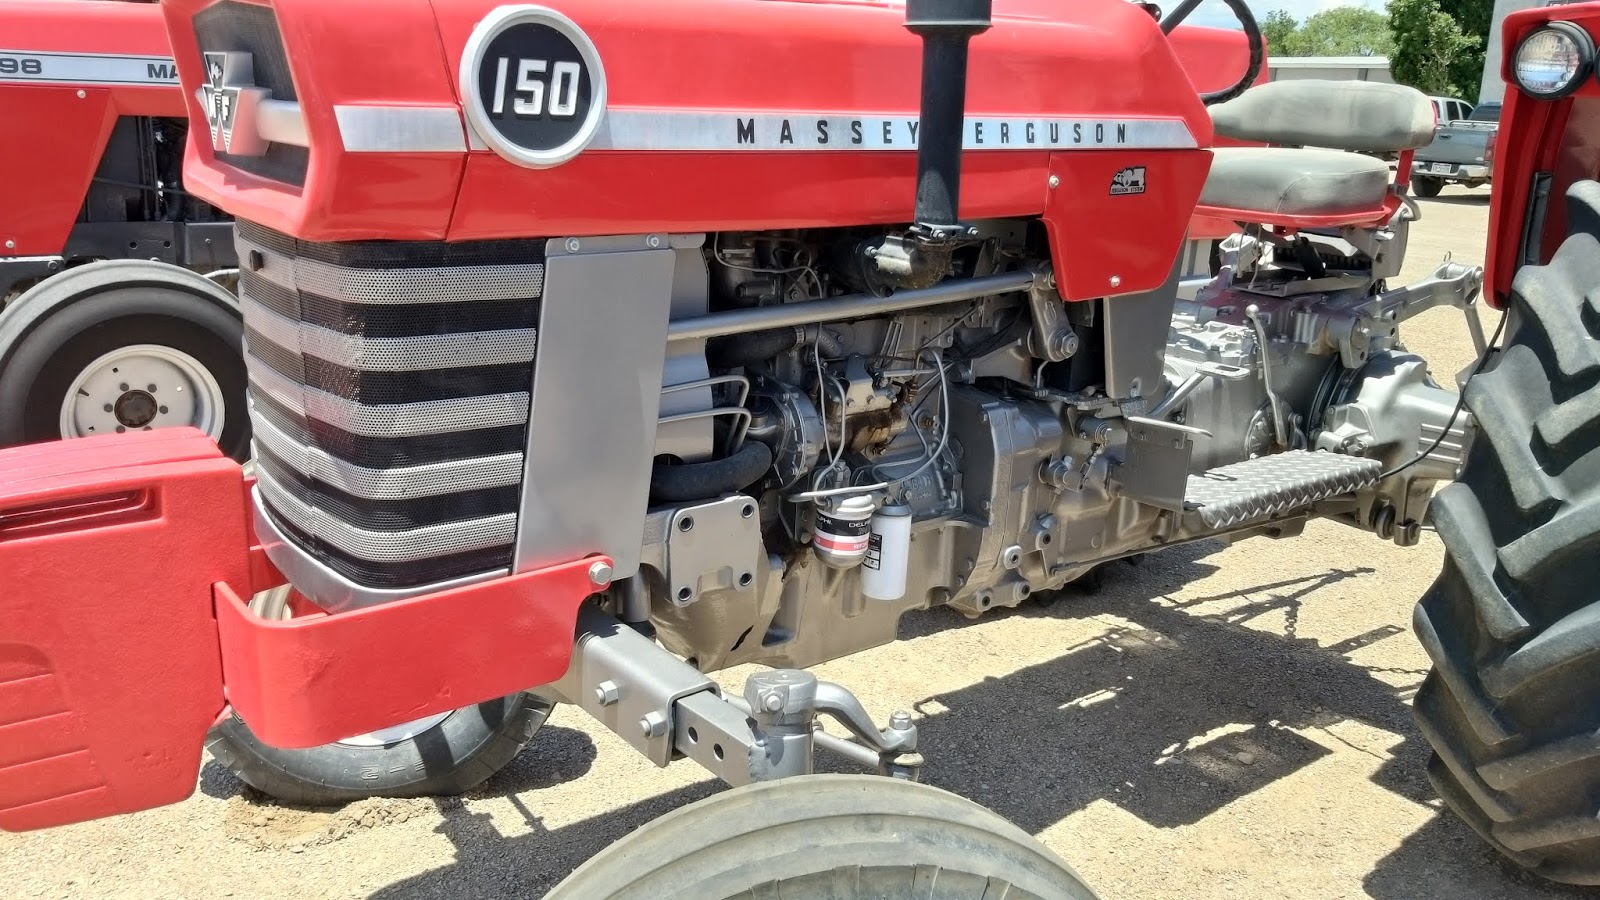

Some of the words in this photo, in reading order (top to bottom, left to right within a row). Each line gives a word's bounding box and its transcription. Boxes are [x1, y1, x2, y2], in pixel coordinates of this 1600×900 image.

[492, 57, 581, 116] 150
[737, 118, 919, 144] MASSEY
[975, 122, 1126, 144] ERGUSON
